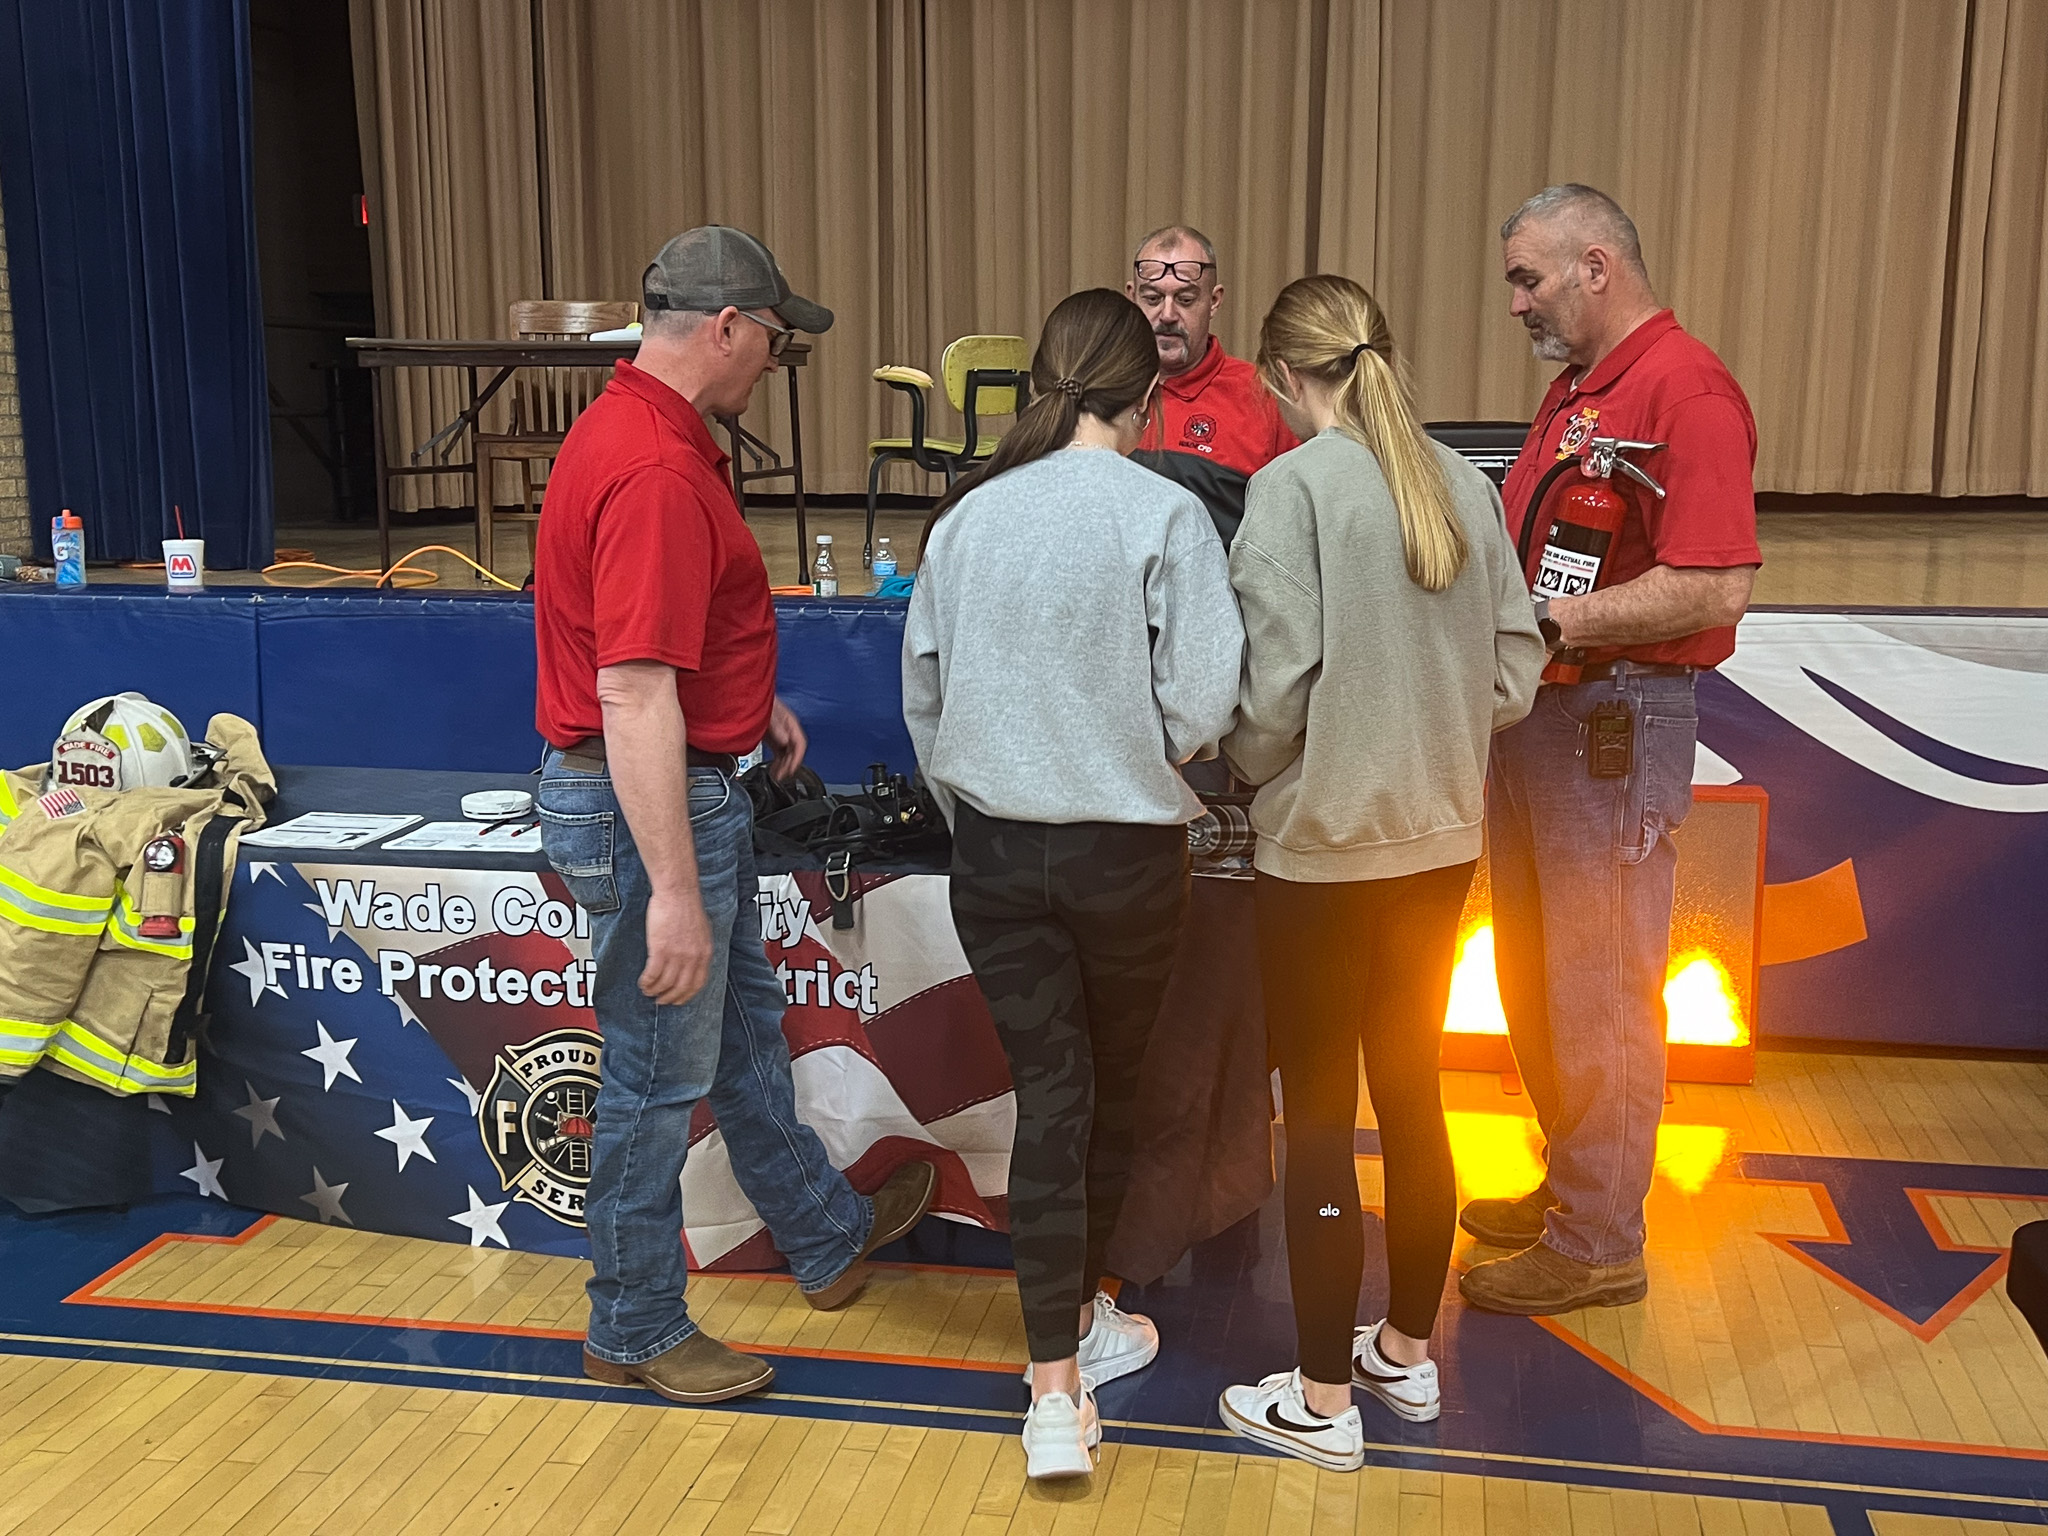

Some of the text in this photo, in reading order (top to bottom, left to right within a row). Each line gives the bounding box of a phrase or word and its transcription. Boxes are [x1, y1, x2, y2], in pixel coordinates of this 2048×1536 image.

[1582, 559, 1596, 568] FIRE
[57, 760, 115, 788] 1503
[313, 878, 811, 949] Wade Coity
[260, 941, 878, 1015] Fire Protecti trict
[519, 1049, 597, 1078] PROUD
[496, 1100, 517, 1154] F
[531, 1179, 585, 1211] SER
[1319, 1202, 1340, 1217] alo
